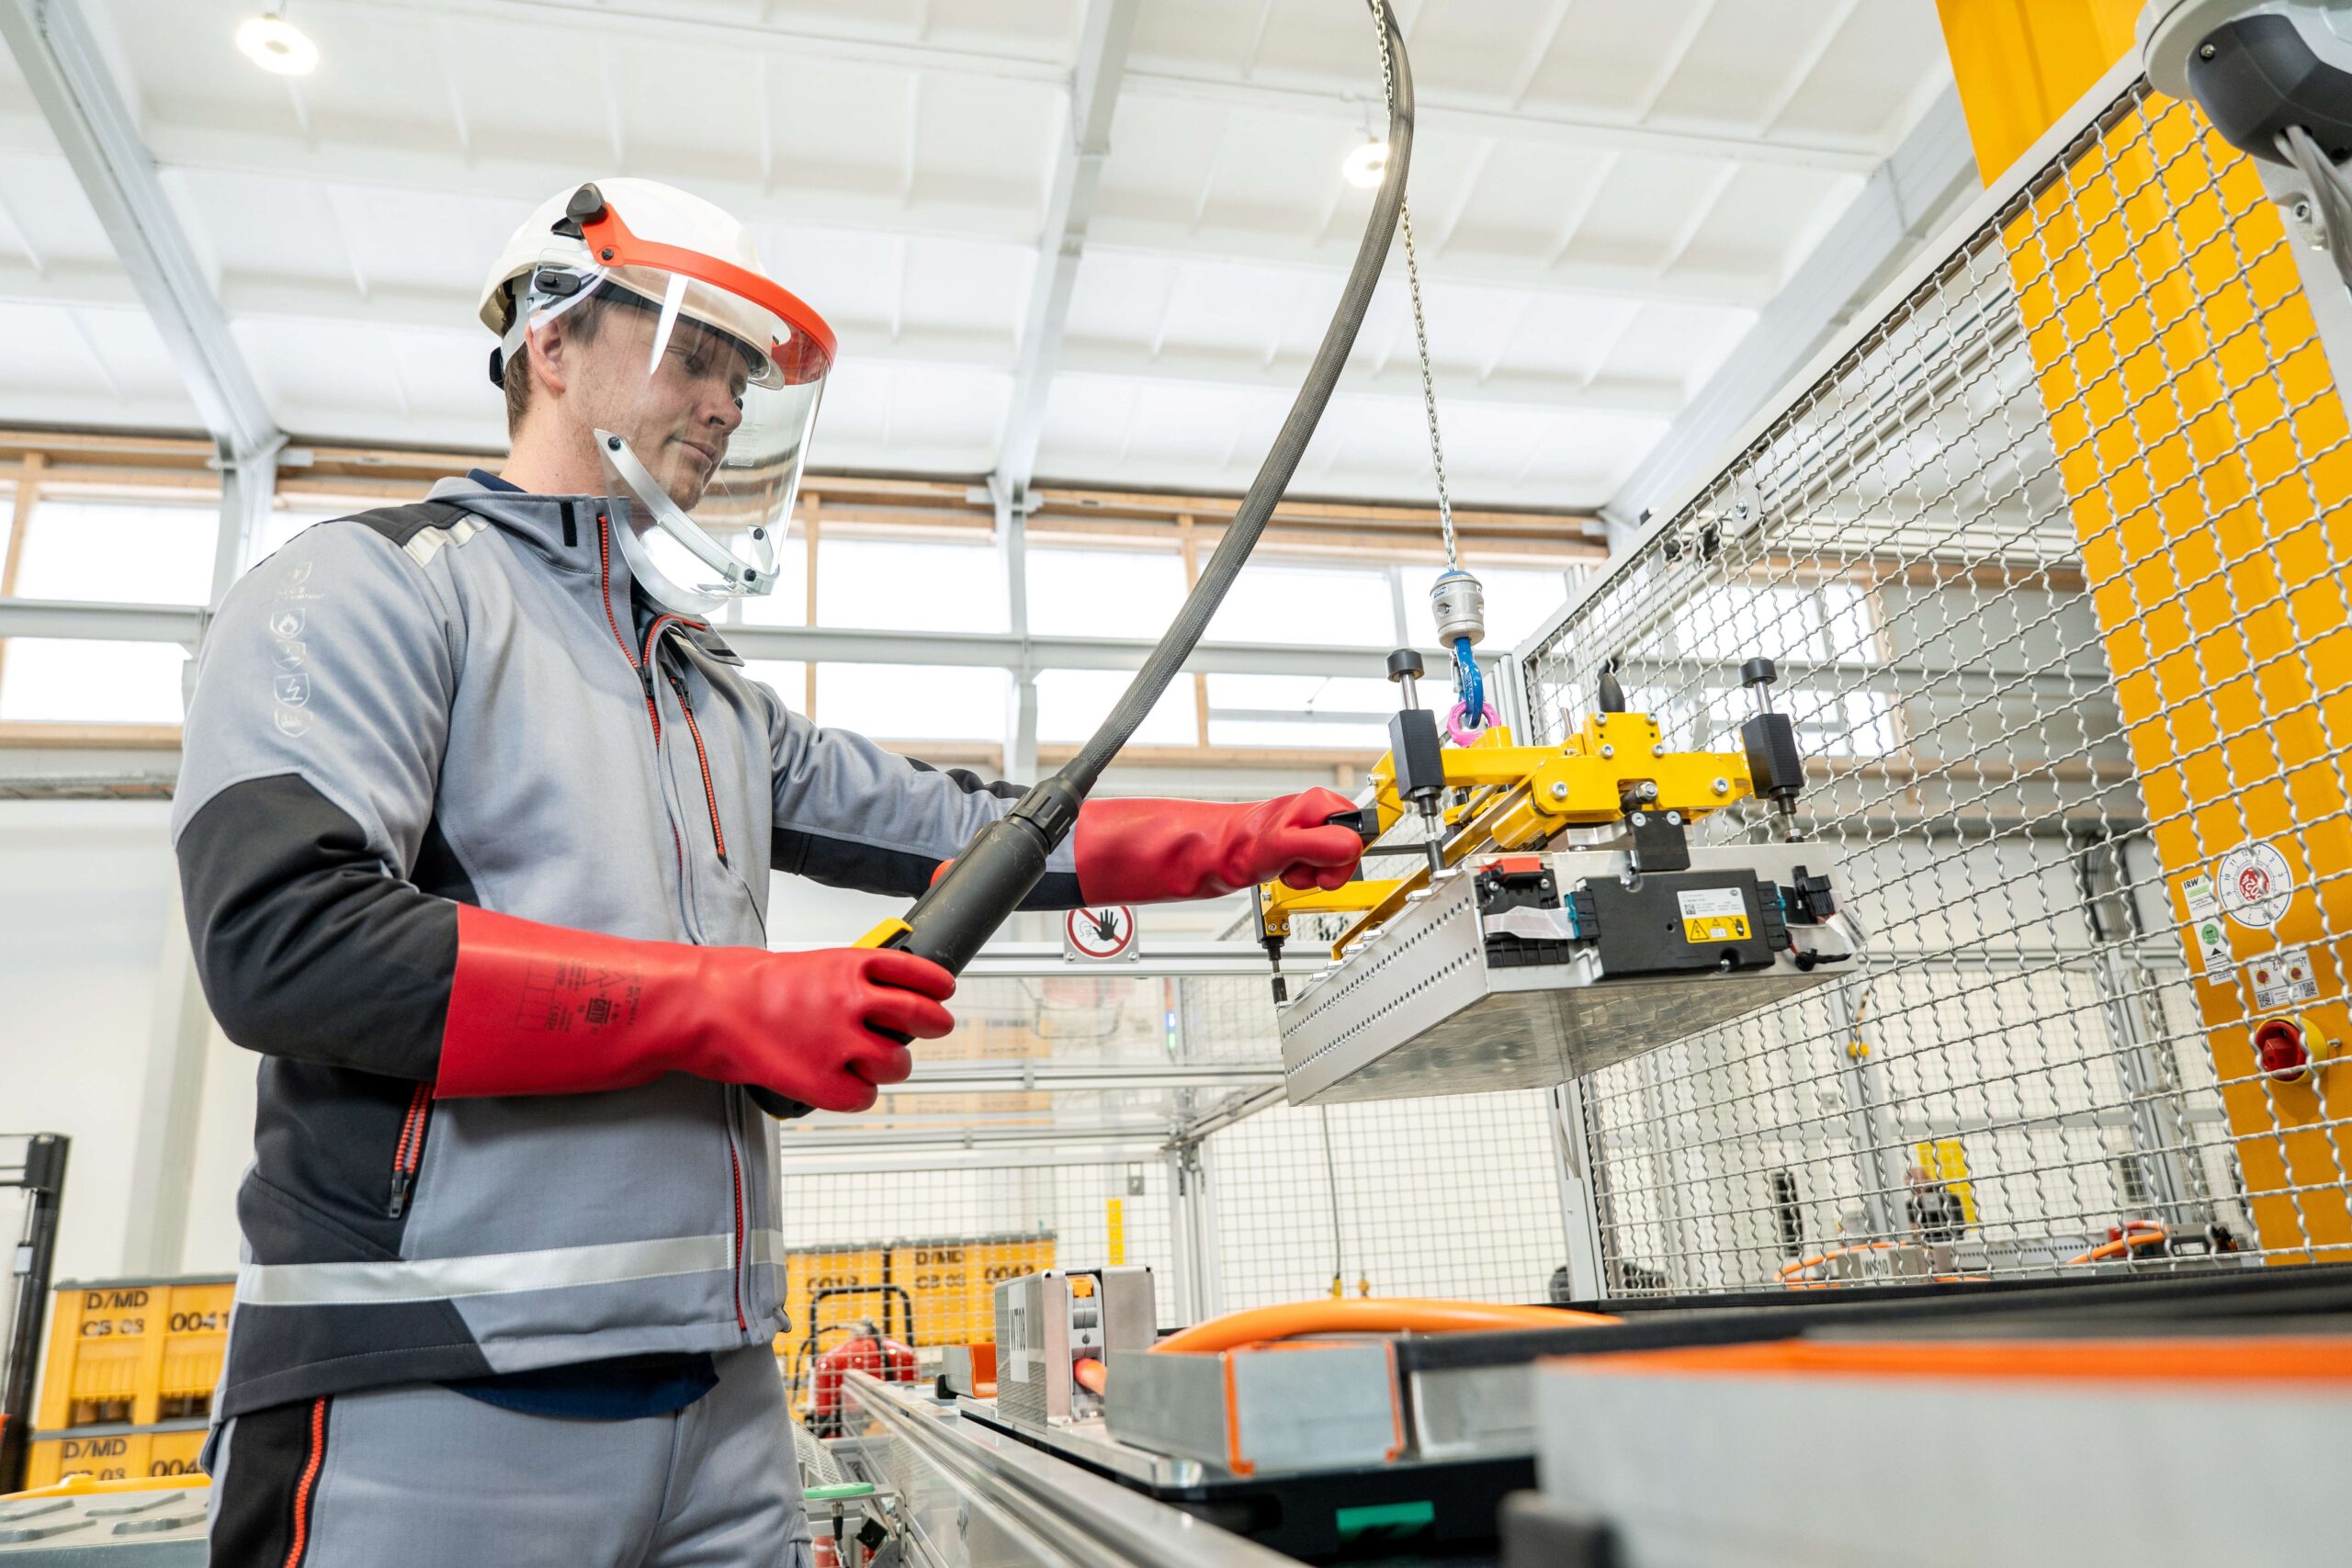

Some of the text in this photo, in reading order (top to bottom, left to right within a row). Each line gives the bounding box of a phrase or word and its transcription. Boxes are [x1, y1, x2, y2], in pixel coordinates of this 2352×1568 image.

[2183, 877, 2199, 890] IRW
[1862, 1259, 1889, 1275] W10
[87, 1291, 149, 1310] D/MD
[81, 1320, 113, 1337] CB
[63, 1438, 127, 1459] D/MD
